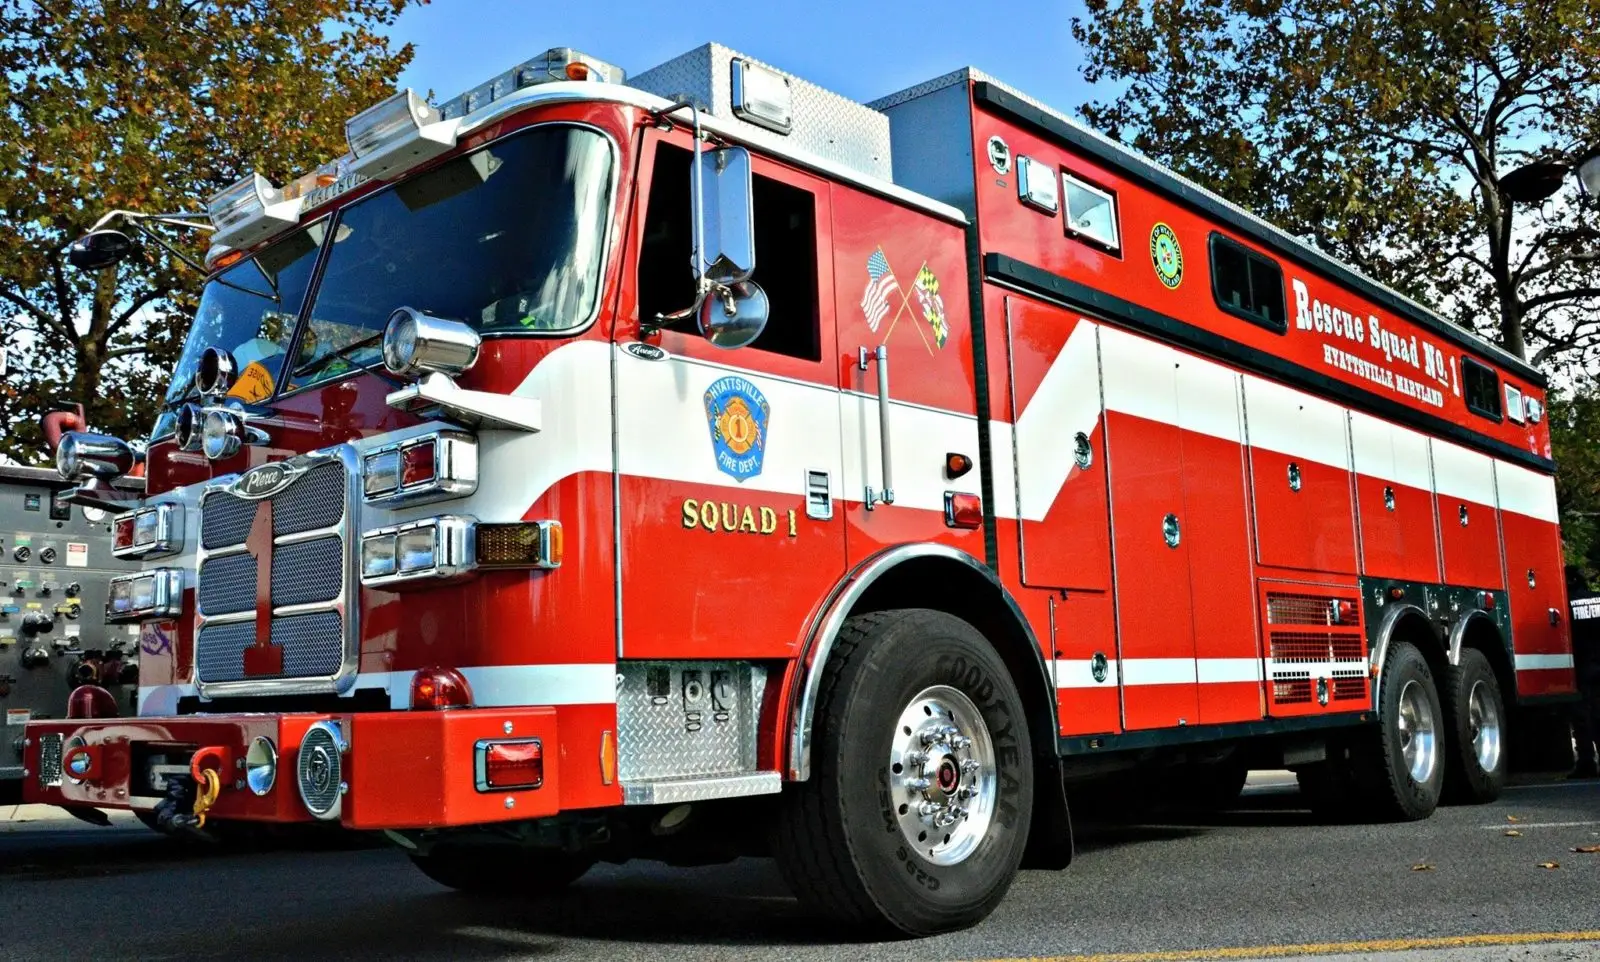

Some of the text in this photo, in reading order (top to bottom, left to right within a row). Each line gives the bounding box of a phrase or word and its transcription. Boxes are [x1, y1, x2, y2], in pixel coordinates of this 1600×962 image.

[1292, 277, 1364, 343] Rescue
[1368, 315, 1420, 369] Squad
[1449, 355, 1461, 398] 1
[710, 378, 764, 406] HYATTSVILLE
[1395, 373, 1444, 408] MARYLAND
[735, 418, 742, 438] 1
[719, 451, 737, 472] FIRE
[246, 470, 279, 492] Pierce
[682, 498, 777, 534] SQUAD
[935, 653, 1020, 830] GOODYEAR
